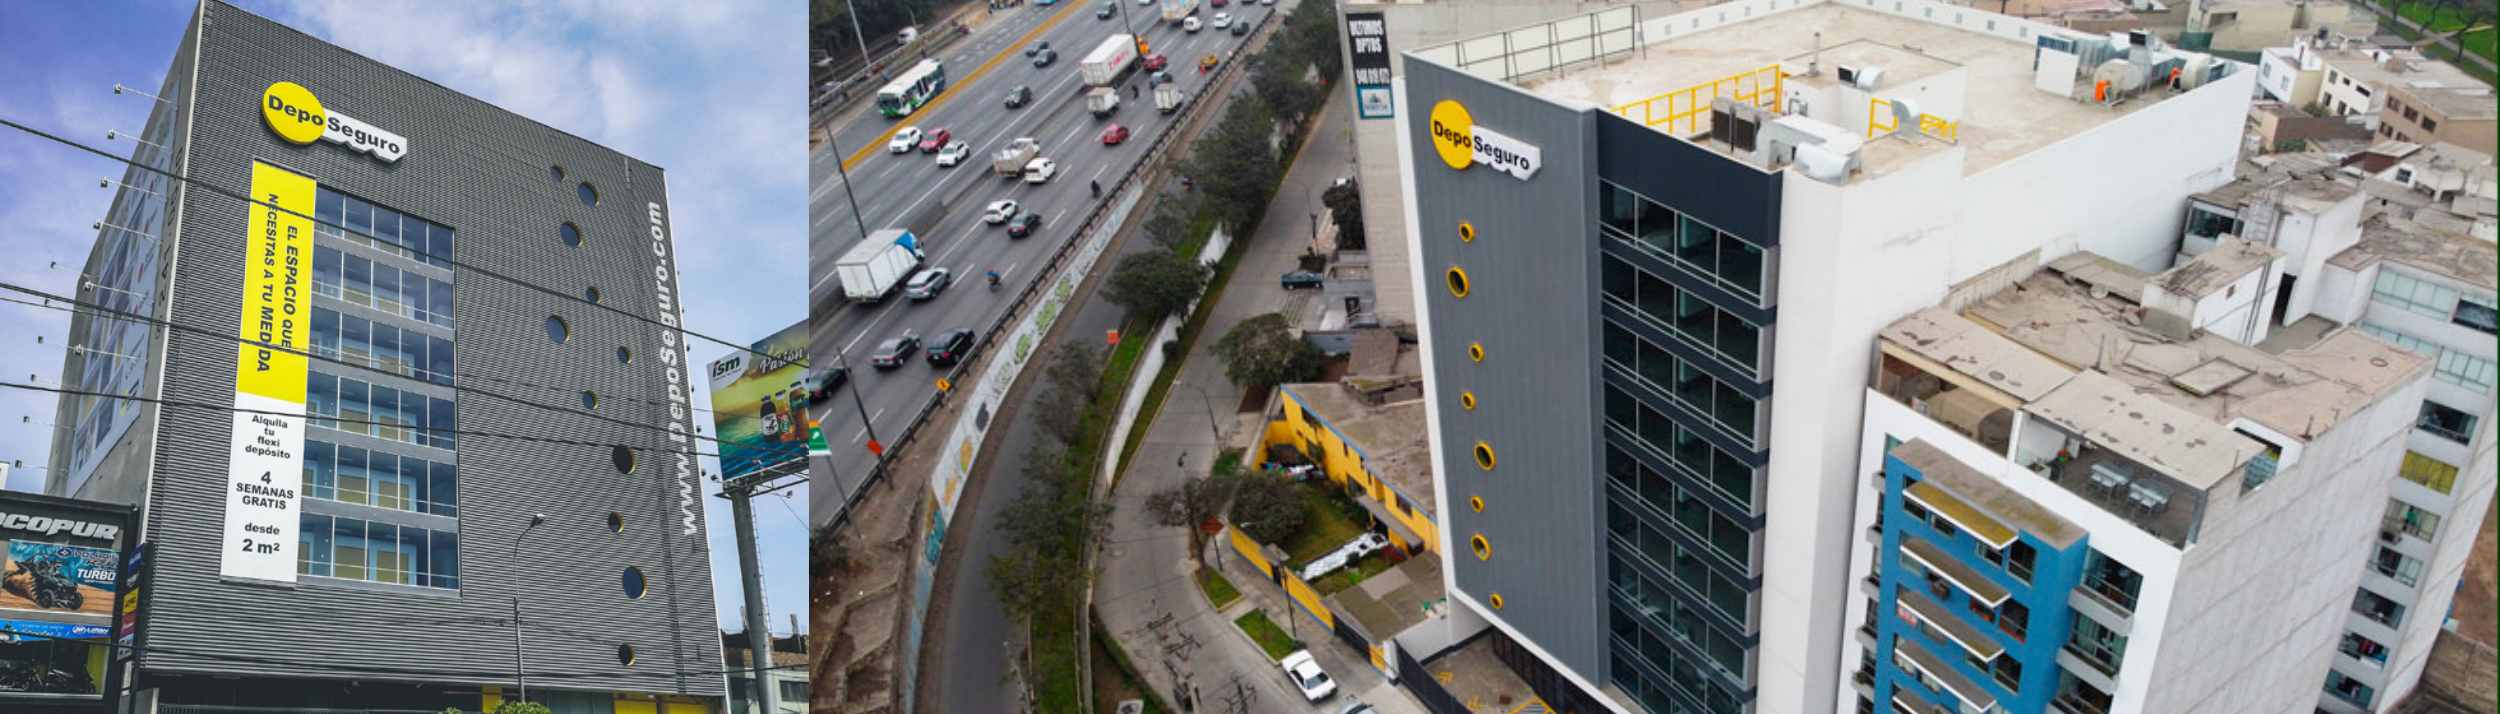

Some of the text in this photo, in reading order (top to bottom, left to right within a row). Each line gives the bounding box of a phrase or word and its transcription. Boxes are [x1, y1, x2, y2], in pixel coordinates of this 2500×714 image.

[268, 94, 401, 155] Depo Seguro
[1434, 120, 1530, 170] Depo Seguro
[263, 271, 273, 279] A
[261, 283, 273, 303] TU
[281, 225, 298, 351] EL ESPACIO QUE
[256, 306, 274, 372] MEDDA
[649, 201, 698, 536] www.DepoSeguro.com
[712, 355, 741, 379] ism
[252, 414, 289, 429] Alquila
[264, 428, 276, 437] tu
[257, 436, 281, 448] flexi
[244, 445, 291, 460] depósito
[261, 471, 272, 485] 4
[236, 482, 294, 500] SEMANAS
[242, 495, 287, 510] GRATIS
[244, 522, 281, 536] desde
[242, 538, 254, 553] 2
[77, 568, 117, 581] TURBO
